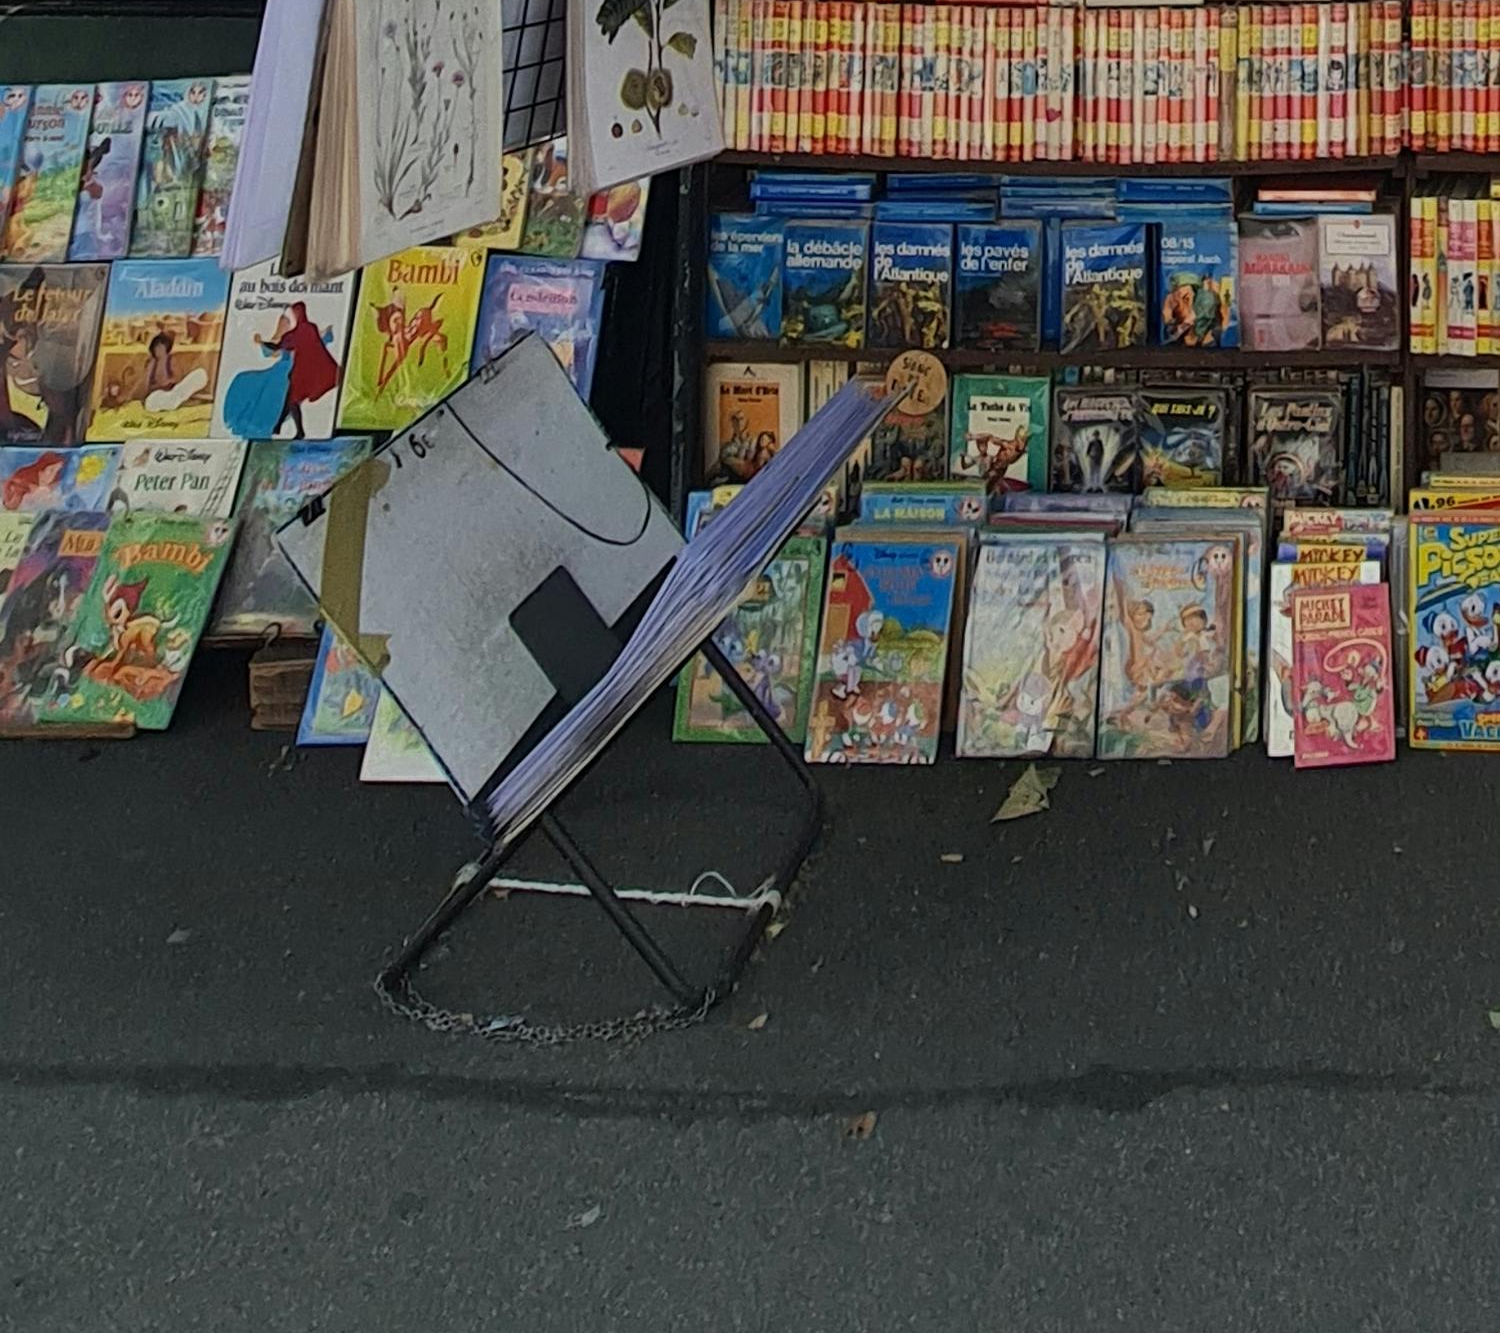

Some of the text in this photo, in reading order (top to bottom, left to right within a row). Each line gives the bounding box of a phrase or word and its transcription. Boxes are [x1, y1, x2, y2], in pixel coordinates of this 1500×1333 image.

[786, 238, 800, 254] la
[873, 241, 951, 258] les damnés
[960, 241, 981, 257] les
[1064, 240, 1145, 260] les damnés
[785, 254, 864, 270] allemande
[960, 256, 979, 271] de
[386, 258, 461, 286] Bambi
[135, 276, 205, 299] Aladdin
[239, 281, 257, 294] au
[259, 278, 287, 294] bois
[133, 472, 210, 493] Peter Pan
[114, 539, 215, 577] Bambi
[1300, 548, 1365, 563] MICKEY
[1293, 564, 1360, 586] MICKEY
